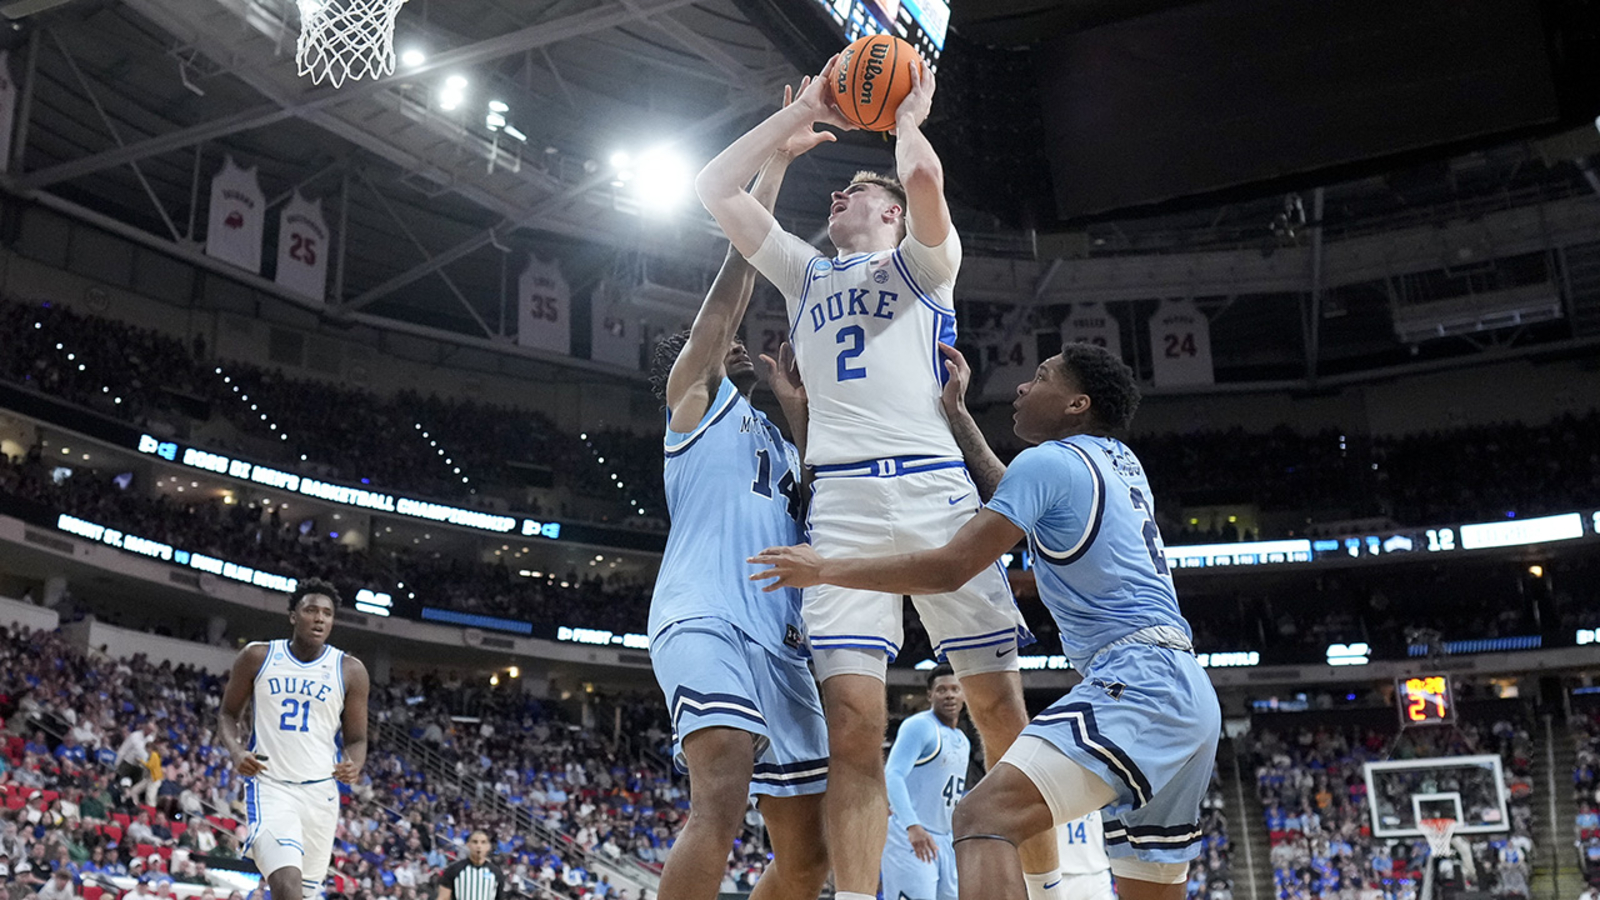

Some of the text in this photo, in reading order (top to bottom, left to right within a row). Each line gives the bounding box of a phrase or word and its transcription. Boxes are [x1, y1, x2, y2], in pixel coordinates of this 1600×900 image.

[860, 43, 890, 105] Wilson
[289, 232, 316, 266] 25
[531, 294, 558, 322] 35
[810, 288, 898, 333] DUKE
[835, 324, 867, 382] 2
[1163, 332, 1197, 360] 24
[876, 458, 897, 477] D
[300, 478, 395, 511] BASKETBALL
[750, 449, 800, 522] 14
[1128, 485, 1170, 576] 2
[1425, 528, 1455, 551] 12
[58, 514, 104, 540] MOUNT
[123, 535, 172, 560] MARY'S
[190, 553, 224, 574] DUKE
[223, 562, 253, 582] BLUE
[253, 570, 297, 592] DEVILS
[572, 628, 613, 644] FIRST
[1210, 652, 1259, 667] DEVILS
[268, 677, 332, 702] DUKE
[279, 698, 311, 733] 21
[1066, 822, 1087, 844] 14
